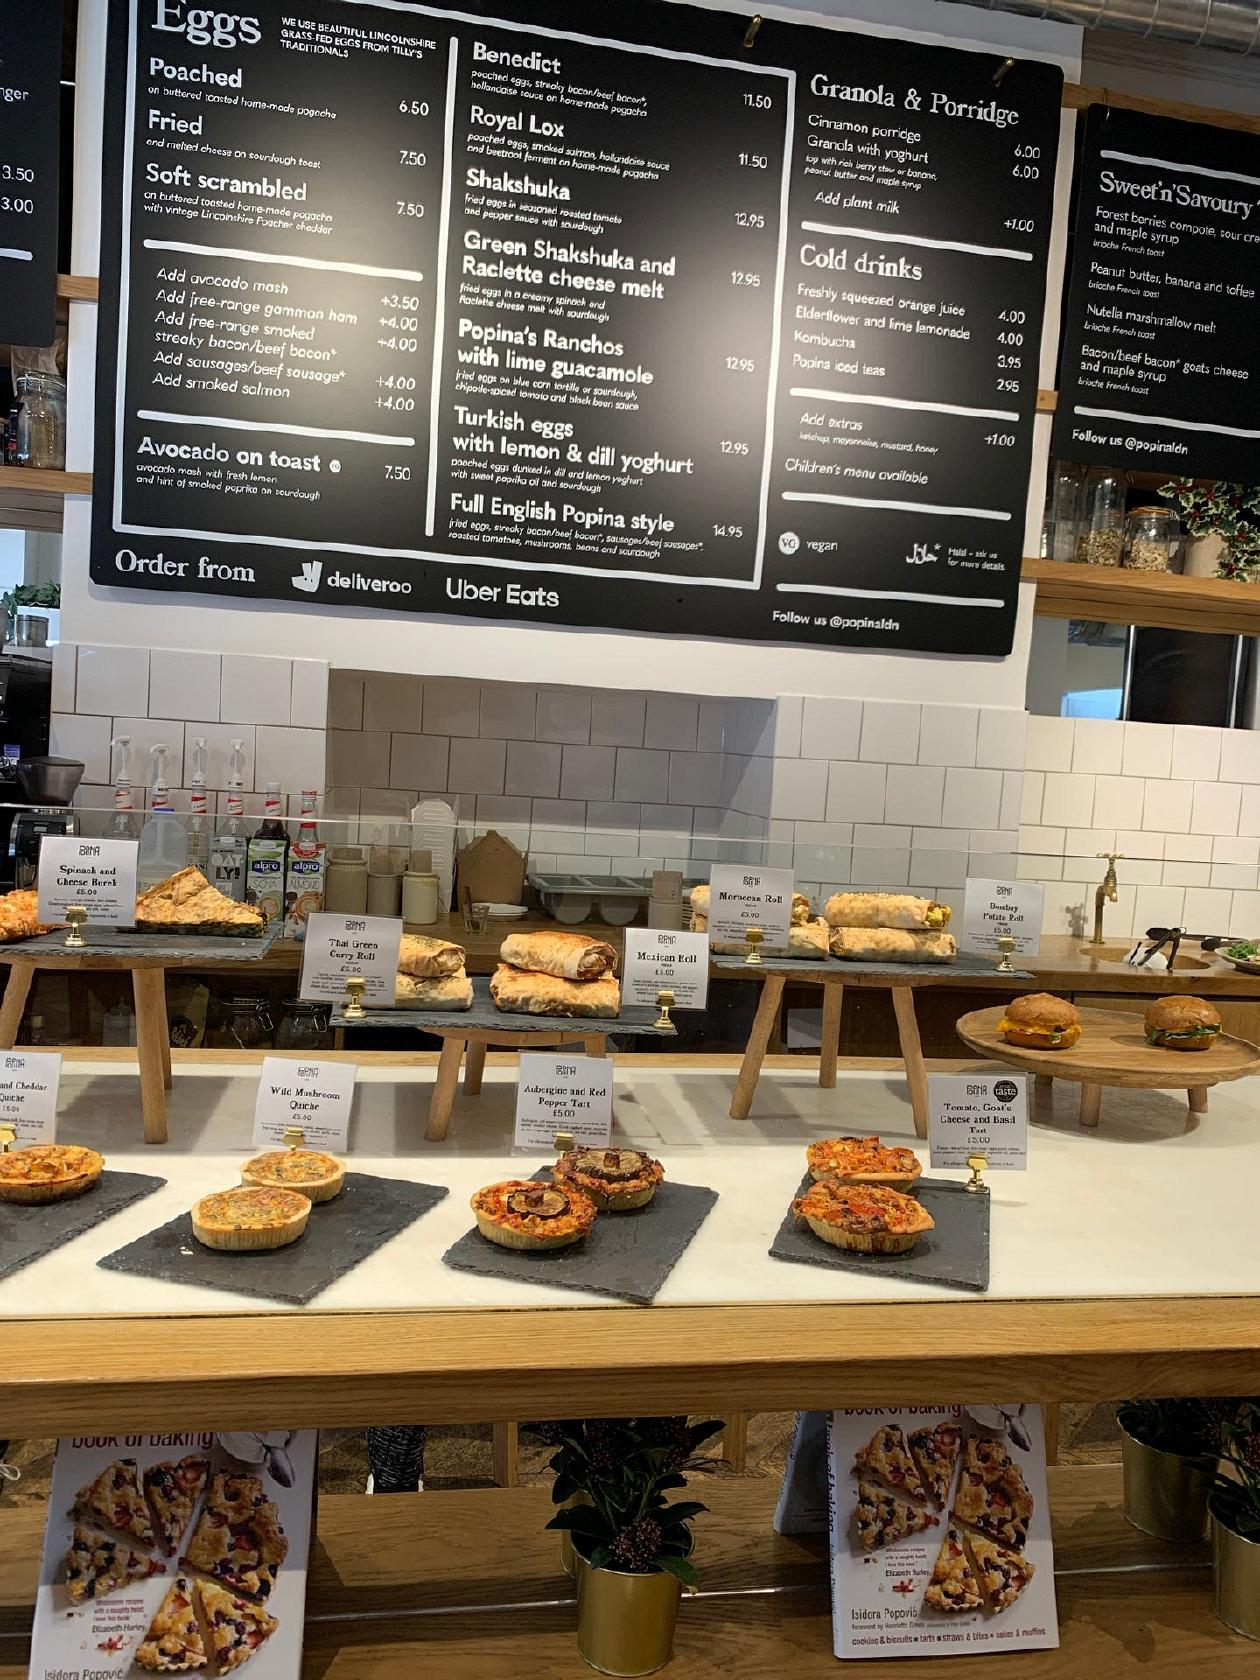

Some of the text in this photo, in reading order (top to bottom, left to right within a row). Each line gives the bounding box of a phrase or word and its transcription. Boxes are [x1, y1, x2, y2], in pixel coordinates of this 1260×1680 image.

[151, 0, 262, 48] Eggs
[282, 17, 436, 49] WE USE BEAUTIFUL LINCOLNSHIRE
[280, 39, 348, 58] TRADITIONALS
[281, 29, 422, 59] GRASS-FED EGGS FROM TILLY'S
[473, 41, 561, 75] Benedict
[149, 57, 242, 88] Poached
[399, 100, 429, 116] 6.50
[743, 93, 771, 109] 11.50
[810, 74, 1019, 127] Granola & Porridge
[148, 109, 202, 136] Fried
[470, 105, 564, 138] Royal Lox
[809, 114, 921, 143] Cinnamon porridge
[399, 150, 426, 166] 7.50
[807, 135, 929, 164] Granola with yoghurt
[1014, 145, 1040, 158] 6.00
[739, 153, 767, 168] 11.50
[2, 165, 34, 182] 3.50
[146, 162, 307, 201] Soft scrambled
[1012, 166, 1039, 180] 6.00
[466, 168, 570, 201] Shakshuka
[1, 197, 33, 213] 3.00
[815, 191, 899, 214] Add plant milk
[1100, 171, 1253, 220] Sweet'n'Savoury
[397, 202, 424, 217] 7.50
[735, 212, 765, 228] 12.95
[1095, 222, 1179, 247] and maple syrup
[464, 230, 675, 277] Green Shakshuka and
[800, 244, 922, 280] Cold drinks
[156, 267, 289, 295] Add avocado mash
[462, 256, 664, 299] Raclette cheese melt
[731, 271, 760, 287] 12.95
[155, 289, 357, 325] Add free-range gammon ham
[381, 294, 419, 311] +3.50
[798, 283, 965, 317] Freshly squeezed orange juice
[379, 316, 418, 332] +4.00
[796, 305, 970, 341] Elderflower and lime lemonade
[998, 310, 1026, 324] 4.00
[1087, 304, 1216, 334] Nutella marshmallow melt
[459, 319, 624, 356] Popina's Ranchos
[794, 330, 855, 350] Kombucha
[997, 332, 1023, 346] 4.00
[457, 347, 653, 385] with lime guacamole
[726, 356, 754, 373] 12.95
[997, 355, 1021, 369] 3.95
[152, 372, 289, 398] Add smoked salmon
[374, 396, 414, 412] +4.00
[454, 405, 573, 440] Turkish eggs
[137, 436, 229, 463] Avocado
[236, 450, 263, 466] on
[269, 453, 321, 473] toast
[453, 433, 693, 475] with lemon & dill yoghurt
[720, 441, 748, 456] 12.95
[136, 463, 277, 484] avocado mash with fresh lemon
[384, 465, 411, 481] 7.50
[785, 458, 928, 485] Children's menu available
[451, 493, 674, 535] Full English Popina style
[713, 524, 743, 538] 14.95
[115, 549, 255, 583] Order from
[328, 571, 411, 594] deliveroo
[446, 577, 559, 608] Uber Eats
[773, 610, 899, 631] Follow us @popinaldn
[211, 853, 244, 866] OAT
[254, 861, 278, 871] alpro
[294, 862, 318, 871] alpro
[60, 865, 96, 875] Spinach
[216, 867, 240, 879] LY!
[57, 878, 117, 886] Cheese Burek
[720, 892, 782, 903] Moroccan Roll
[329, 939, 378, 949] Thai Green
[330, 950, 375, 960] Curry Roll
[638, 952, 696, 963] Mexican Roll
[271, 1086, 340, 1099] Wild Mushroom
[524, 1085, 605, 1096] Aubergine and Red
[290, 1100, 319, 1110] Quiche
[539, 1097, 590, 1108] Pepper Tart
[940, 1116, 1015, 1124] Cheese and Basil
[852, 1609, 880, 1619] Isidora
